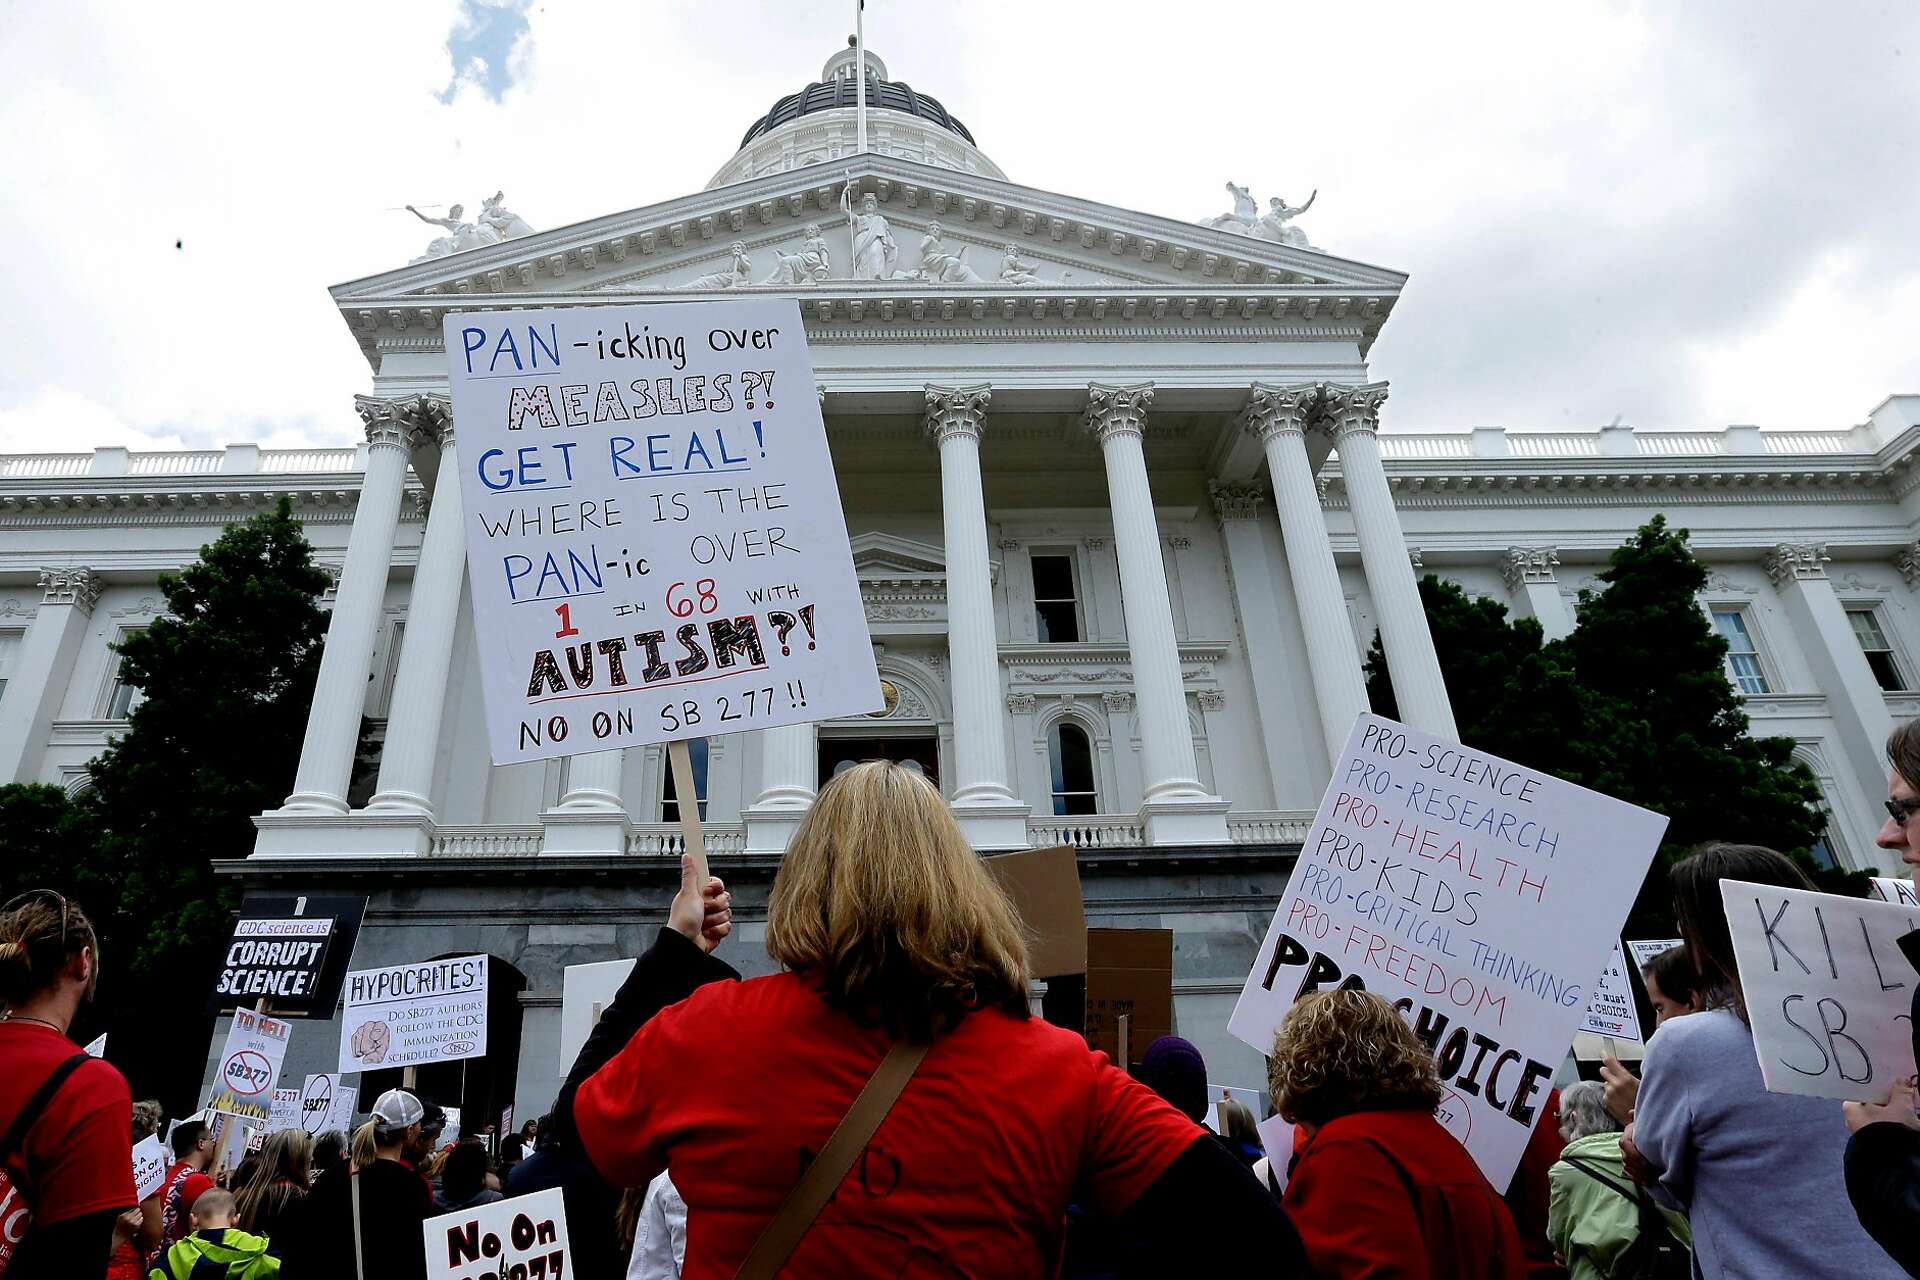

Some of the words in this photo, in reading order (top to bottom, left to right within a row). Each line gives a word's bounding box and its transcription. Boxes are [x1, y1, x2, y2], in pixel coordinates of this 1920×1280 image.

[509, 371, 776, 430] MEASLES?!
[478, 442, 577, 490] GET
[610, 421, 766, 477] REAL!
[479, 498, 622, 538] WHERE
[650, 491, 690, 522] IS
[704, 484, 789, 515] THE
[504, 544, 651, 599] PAN-ic
[690, 526, 800, 564] OVER
[555, 602, 579, 638] 1
[613, 600, 647, 617] IN
[665, 578, 719, 618] 68
[746, 583, 800, 605] WITH
[526, 603, 816, 697] AUTISM?!
[519, 716, 569, 750] NO
[592, 705, 634, 738] ON
[660, 700, 701, 732] SB
[1361, 723, 1542, 804] PRO-SCIENCE
[1345, 758, 1559, 859] PRO-RESEARCH
[1332, 792, 1548, 903] PRO-HEALTH
[1316, 826, 1482, 926] PRO-KIDS
[226, 941, 323, 967] CORRUPT
[239, 921, 266, 935] CDC
[266, 921, 314, 935] science
[316, 921, 329, 935] is
[1300, 863, 1457, 958] PRO-CRITICAL
[1471, 939, 1580, 1008] THINKING
[1755, 898, 1914, 992] KIL
[216, 969, 316, 996] SCIENCE!
[350, 960, 484, 1002] HYPOCRITES!
[1287, 897, 1506, 1026] PRO-FREEDOM
[388, 1011, 406, 1022] DO
[407, 1007, 434, 1020] SB277
[437, 1001, 482, 1015] AUTHORS
[396, 1021, 433, 1034] FOLLOW
[456, 1013, 483, 1027] CDC
[1595, 1003, 1632, 1020] CHOICE.
[1602, 992, 1626, 1004] must
[388, 1047, 439, 1064] SCHEDULE?
[404, 1029, 479, 1047] IMMUNIZATION
[1778, 994, 1873, 1085] SB
[227, 1062, 270, 1083] SB277
[281, 1091, 298, 1102] 277
[303, 1097, 331, 1112] SB277
[148, 1158, 158, 1170] OF
[446, 1220, 502, 1269] No
[510, 1213, 557, 1251] On
